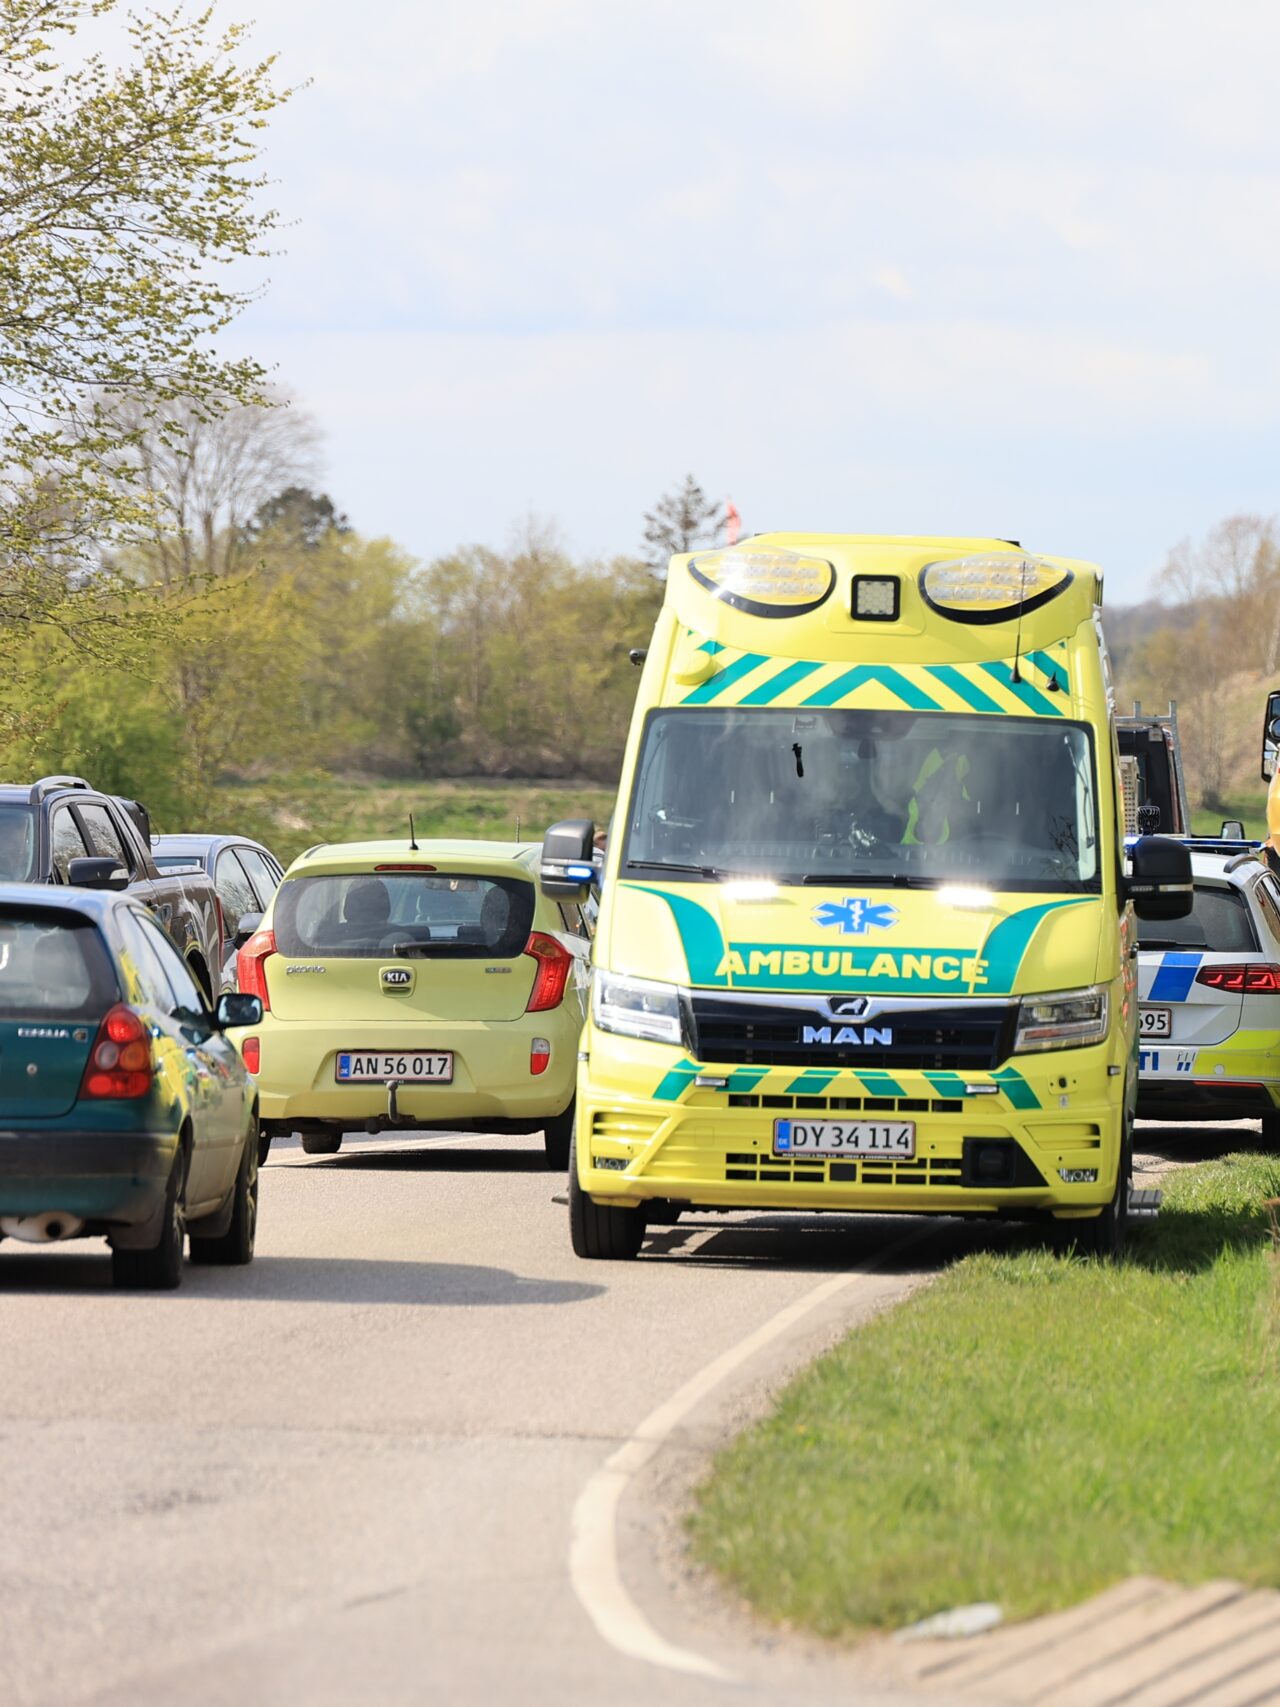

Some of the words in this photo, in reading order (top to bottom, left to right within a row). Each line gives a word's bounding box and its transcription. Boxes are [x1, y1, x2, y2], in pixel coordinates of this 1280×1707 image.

[387, 972, 407, 982] KIA
[715, 951, 988, 985] AMBULANCE
[803, 1026, 892, 1046] MAN
[352, 1057, 378, 1075] AN
[383, 1057, 407, 1075] 56
[413, 1057, 448, 1075] 017
[793, 1126, 825, 1147] DY
[831, 1126, 859, 1148] 34
[868, 1127, 909, 1149] 114
